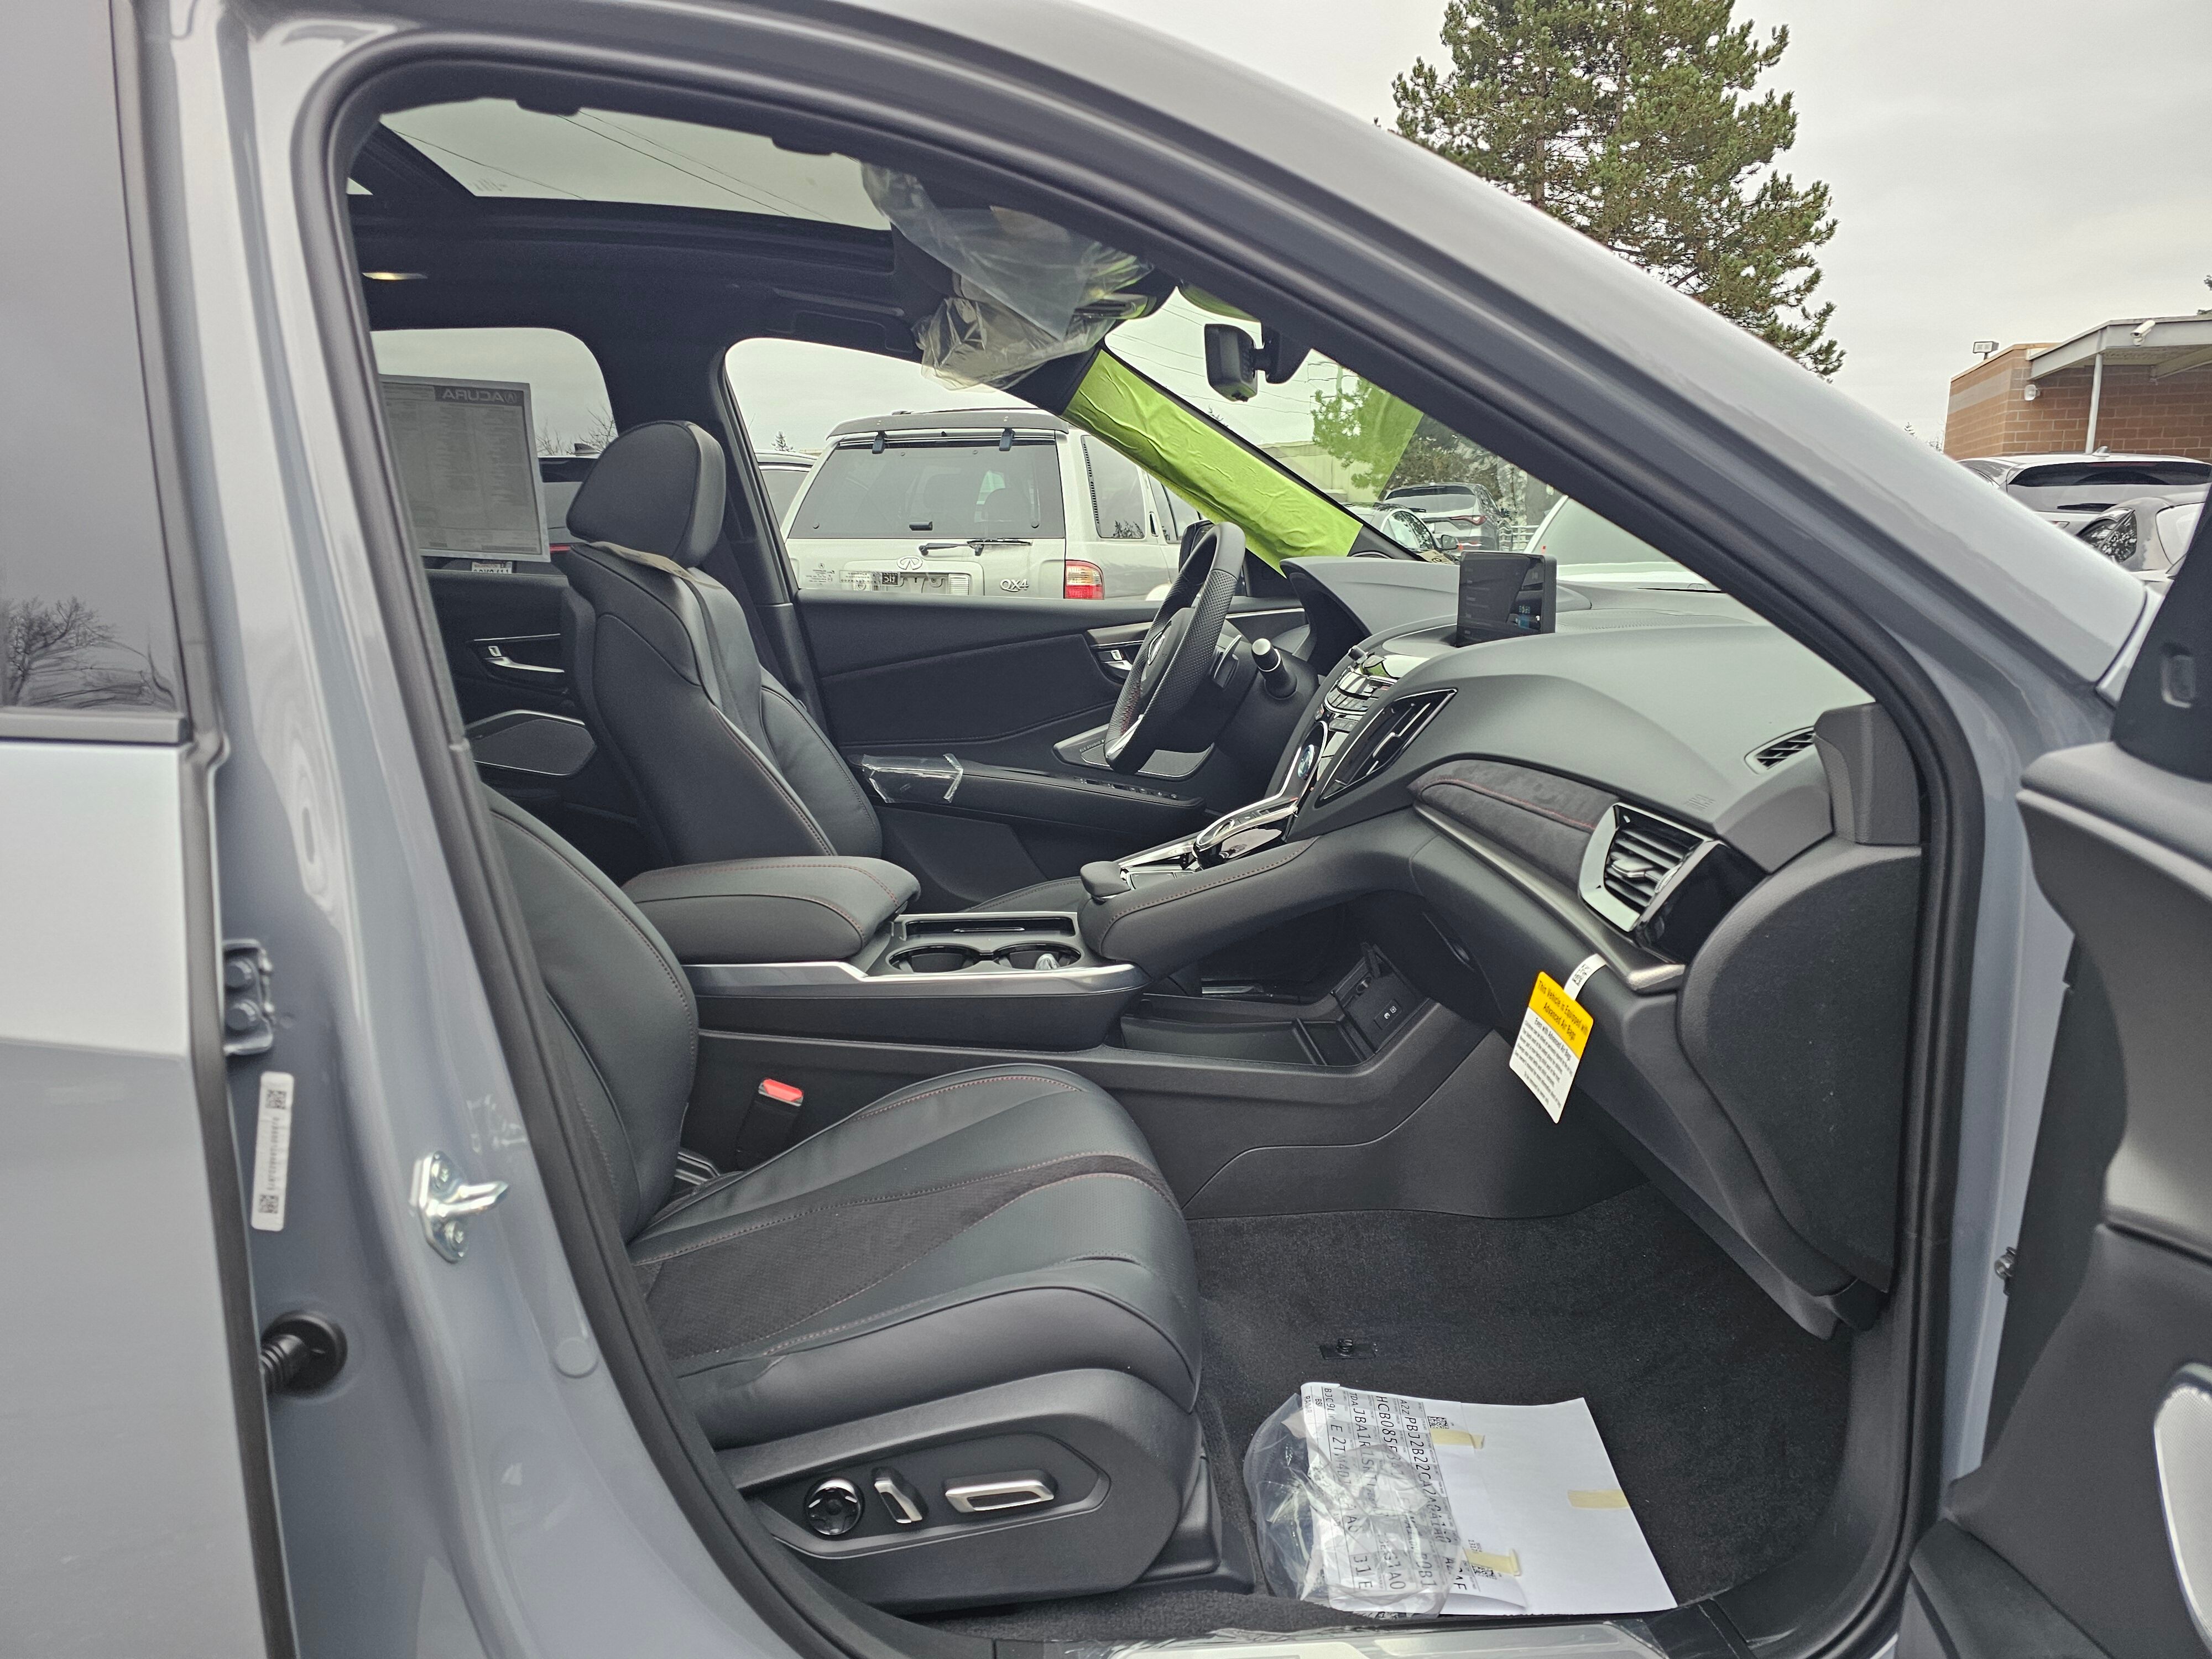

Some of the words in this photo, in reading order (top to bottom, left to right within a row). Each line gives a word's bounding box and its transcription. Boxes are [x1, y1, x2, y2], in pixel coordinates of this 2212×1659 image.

[999, 578, 1029, 592] QX4
[1543, 1001, 1561, 1024] Advanced
[1566, 1024, 1576, 1042] Bags
